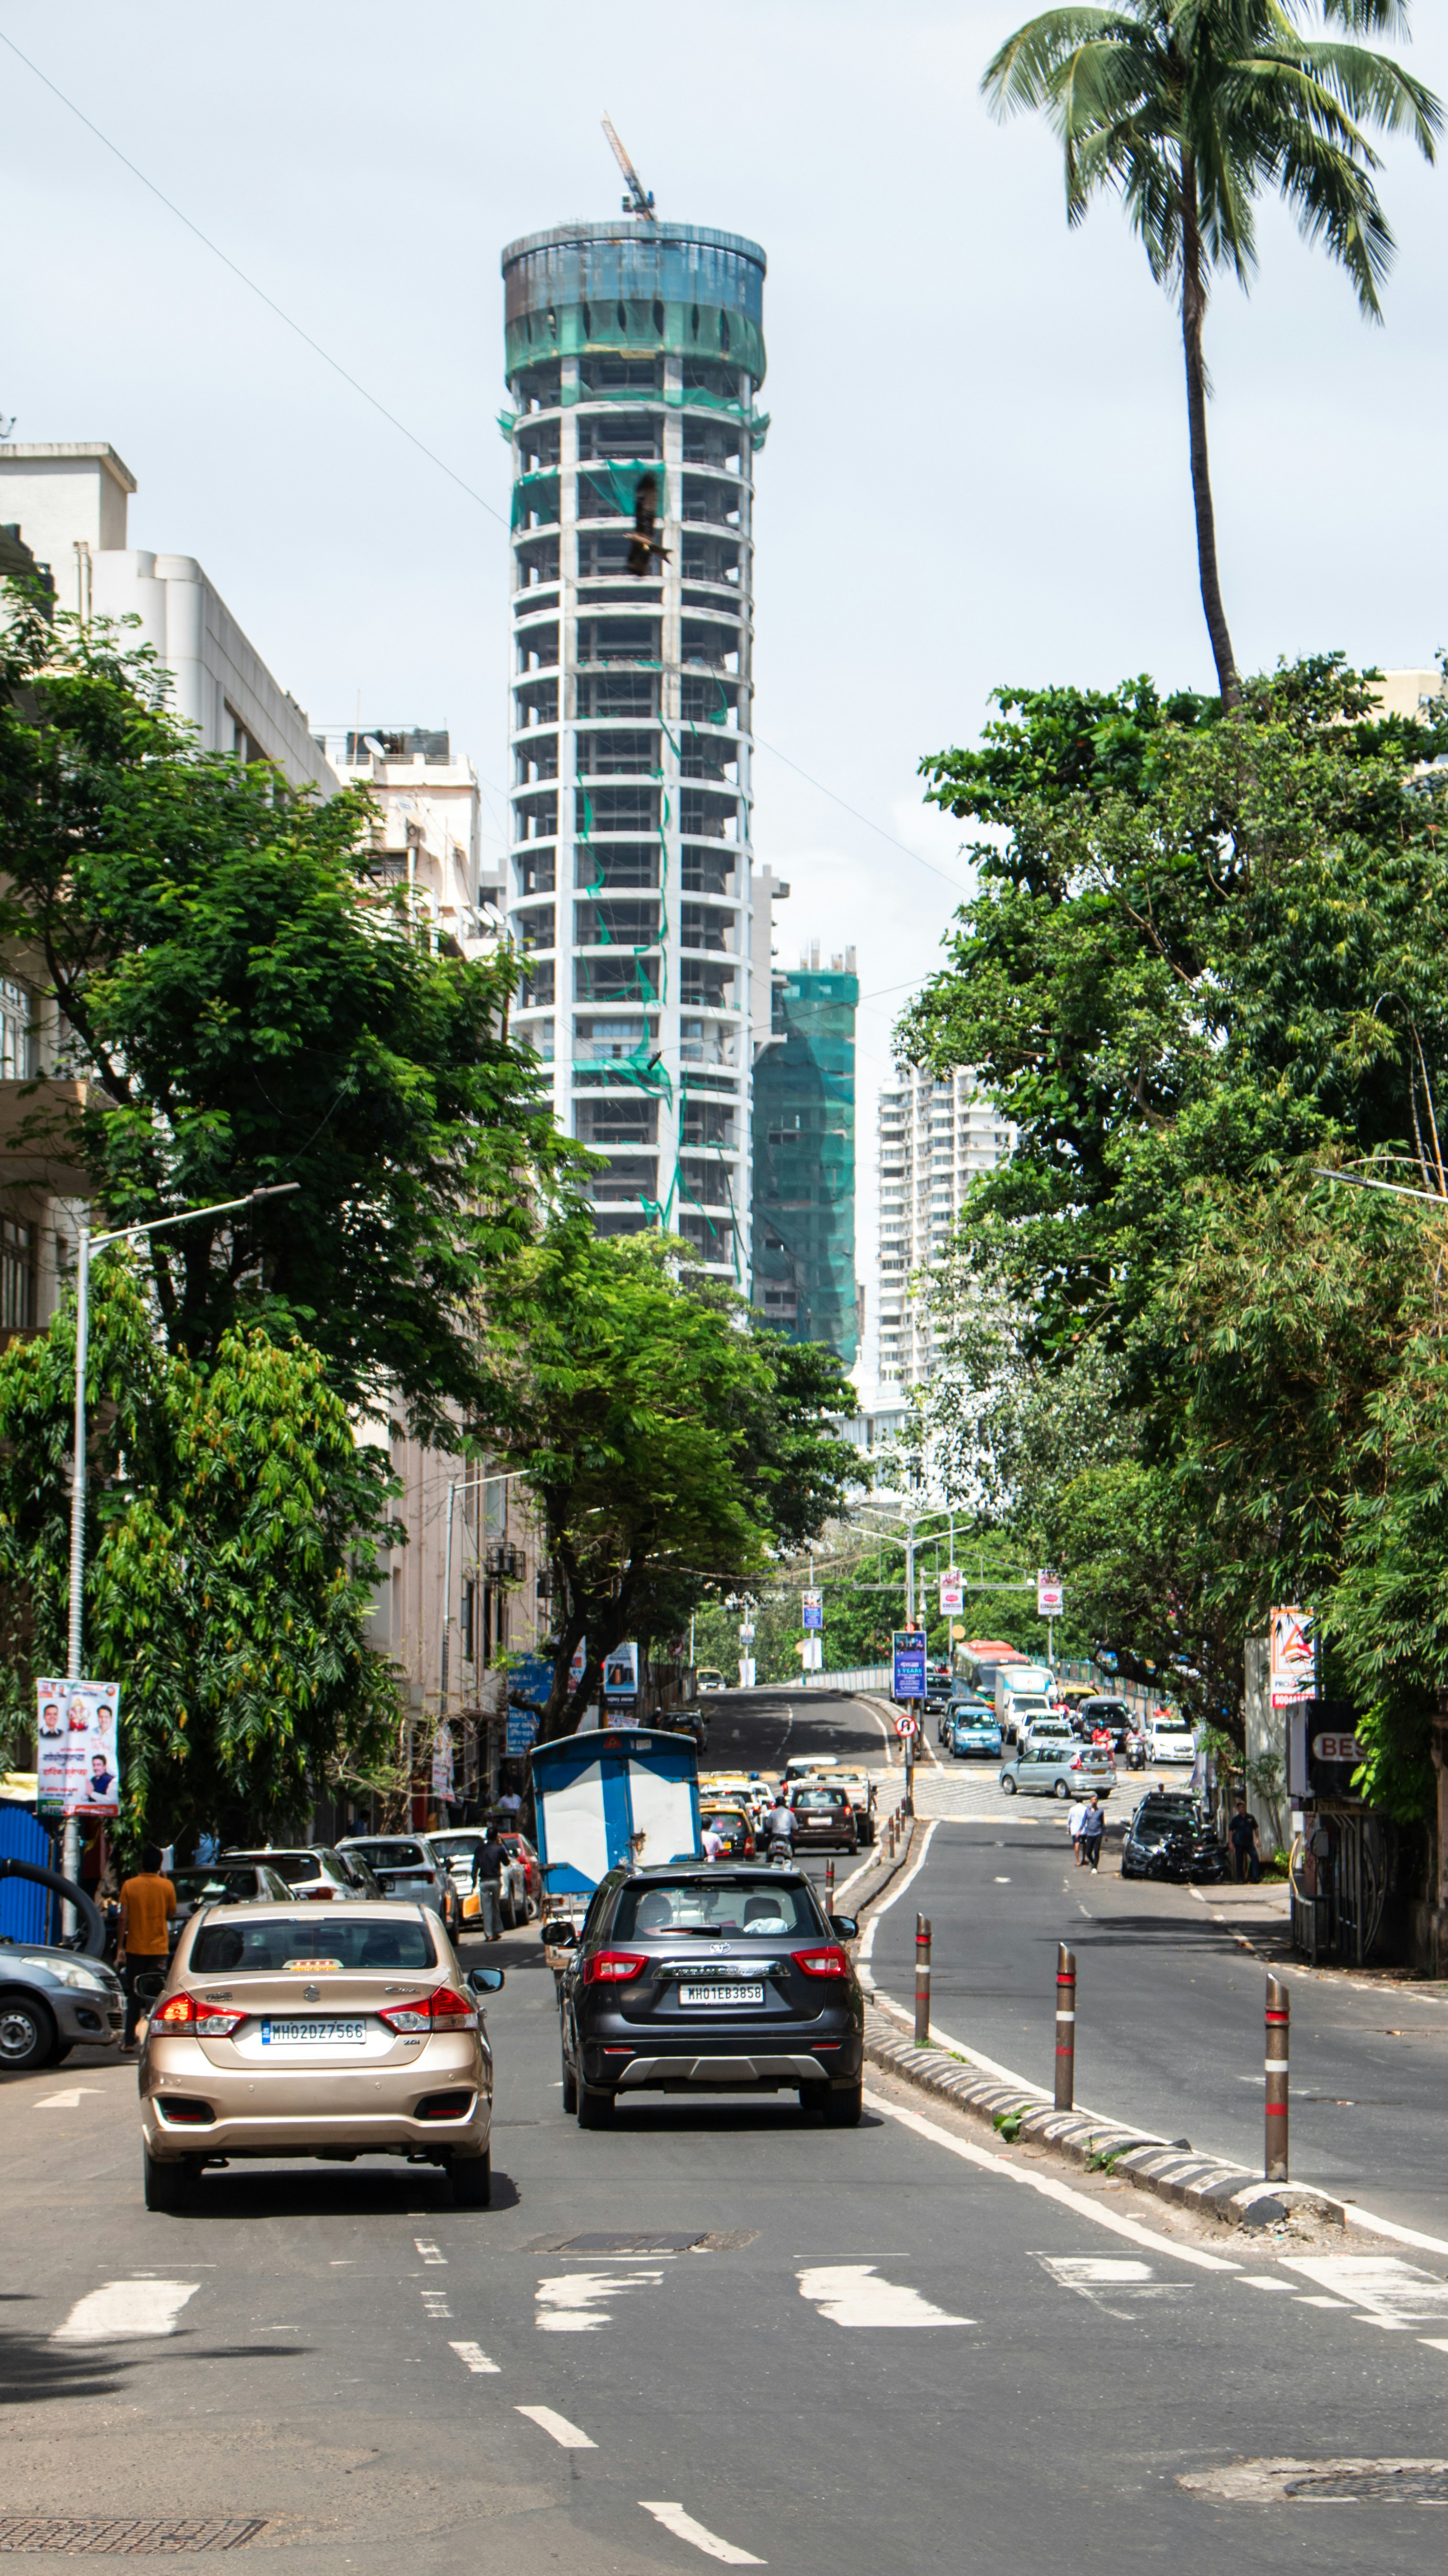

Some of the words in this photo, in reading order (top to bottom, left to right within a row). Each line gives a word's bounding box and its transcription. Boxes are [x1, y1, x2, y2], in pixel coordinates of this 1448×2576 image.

[1322, 1737, 1373, 1757] BES
[688, 1987, 761, 2000] MH01EB3858
[272, 2024, 363, 2039] MH02DZ7566
